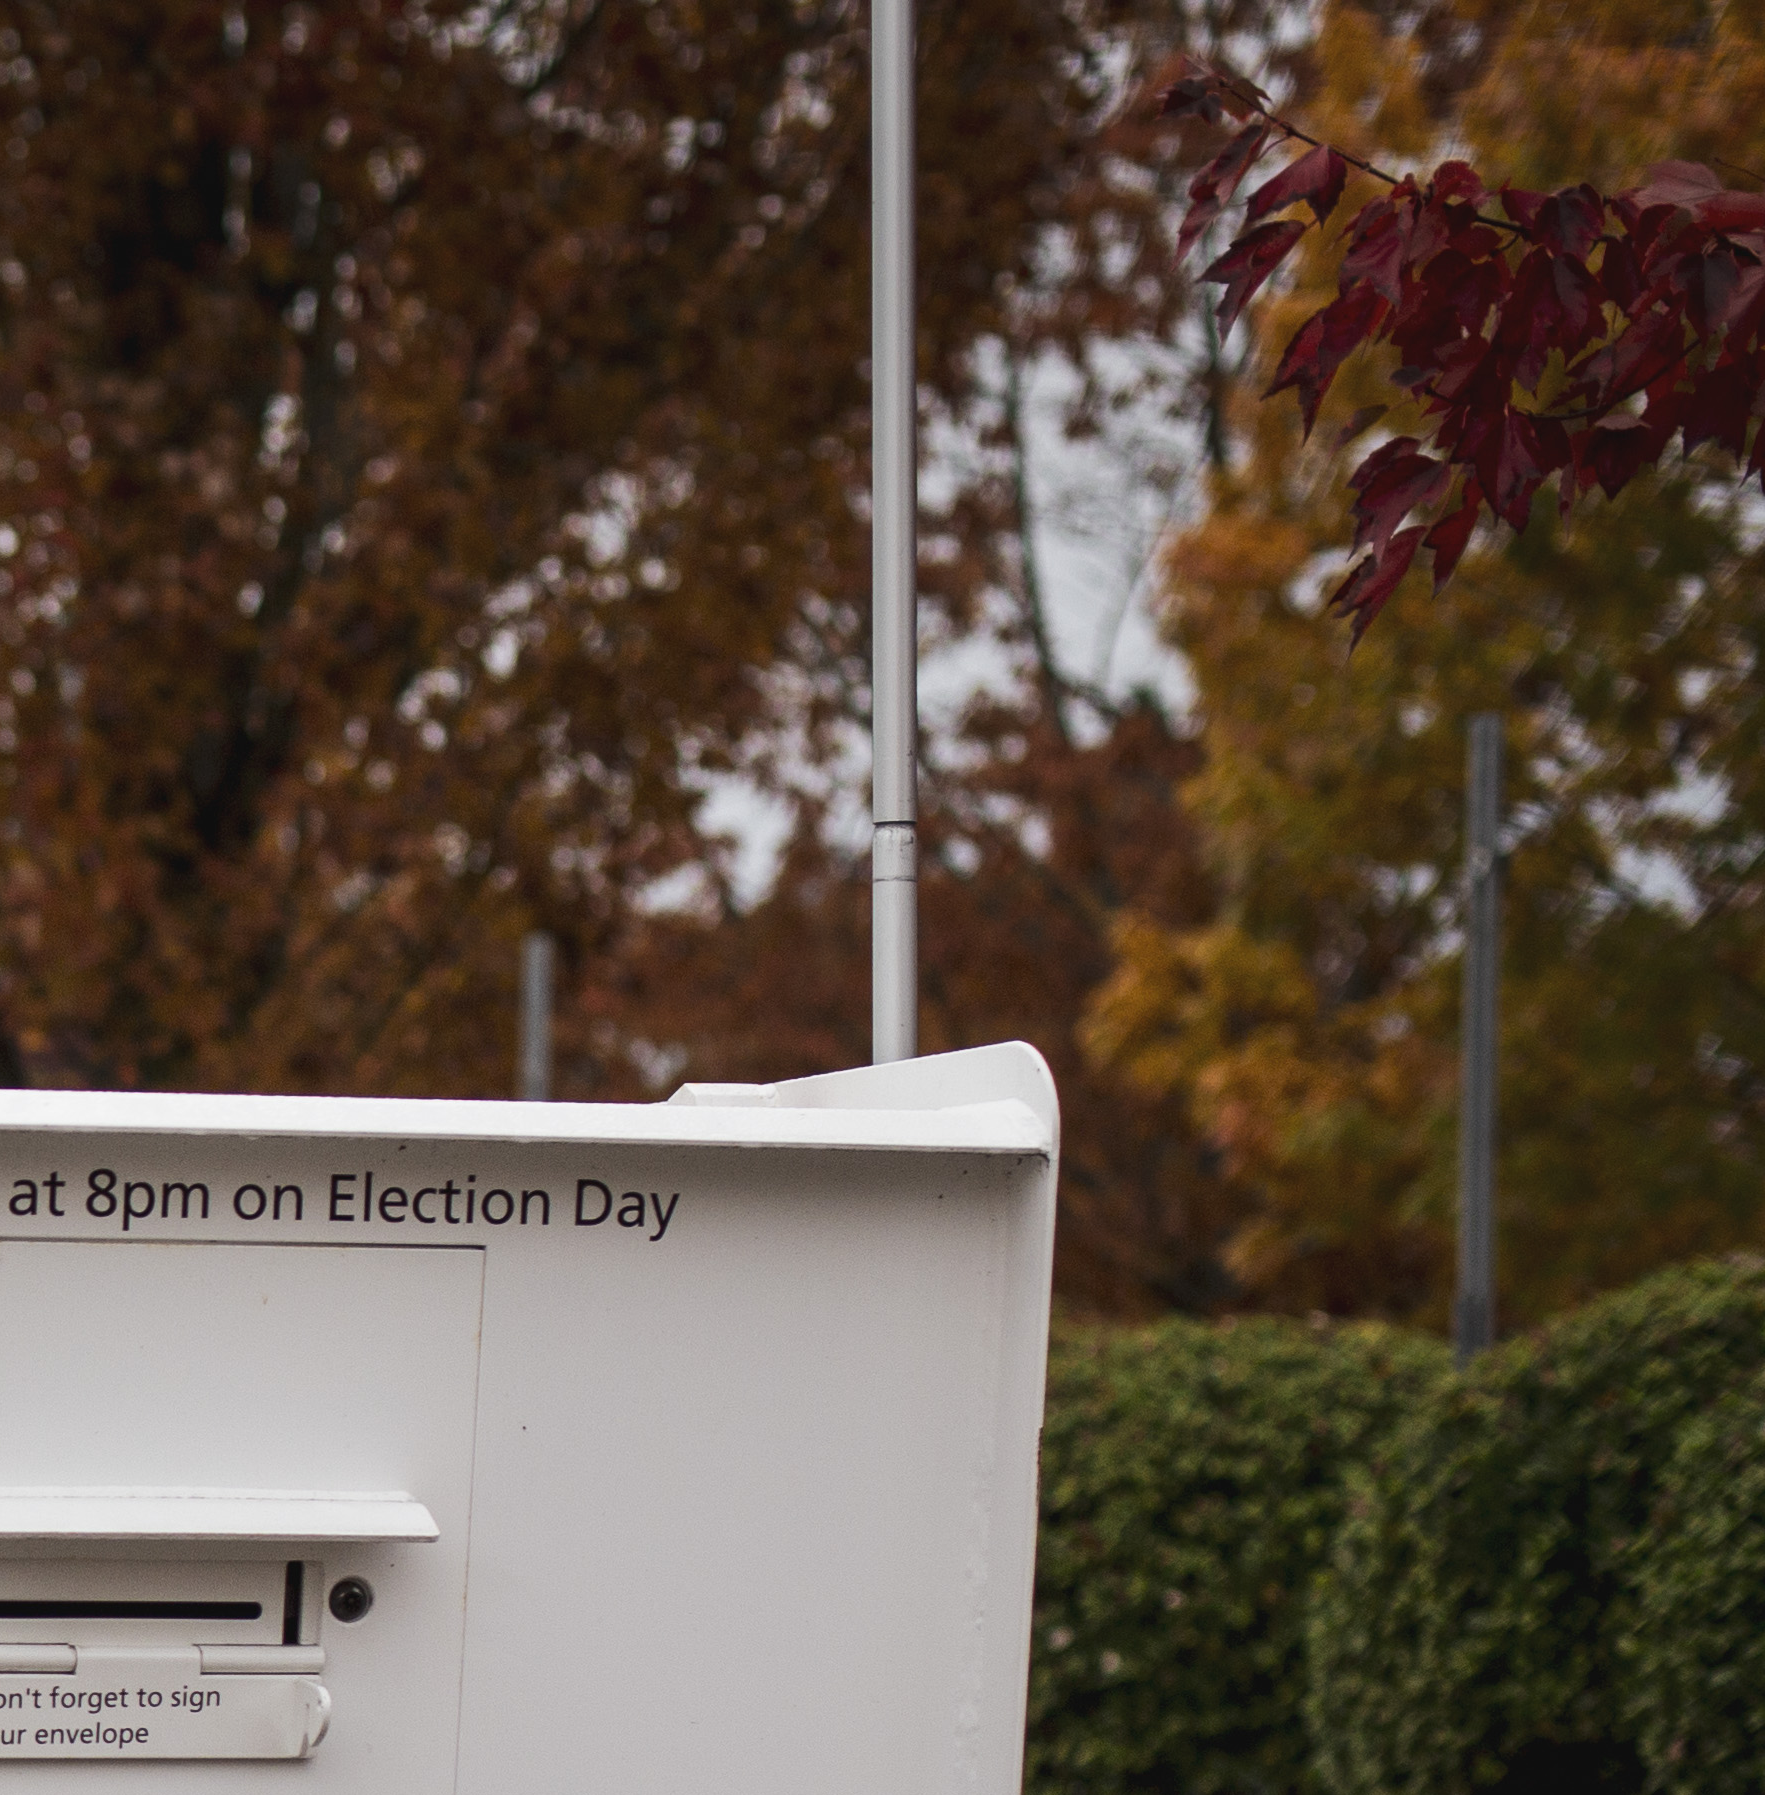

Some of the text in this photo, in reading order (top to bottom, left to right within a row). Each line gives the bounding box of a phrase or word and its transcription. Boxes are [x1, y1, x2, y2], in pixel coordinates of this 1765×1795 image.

[8, 1170, 67, 1217] at
[85, 1167, 210, 1232] 8pm
[233, 1183, 304, 1221] on
[329, 1170, 551, 1226] Election
[574, 1174, 684, 1242] Day
[49, 1685, 129, 1715] forget
[136, 1688, 163, 1708] to
[171, 1685, 221, 1713] sign
[34, 1721, 149, 1749] envelope
